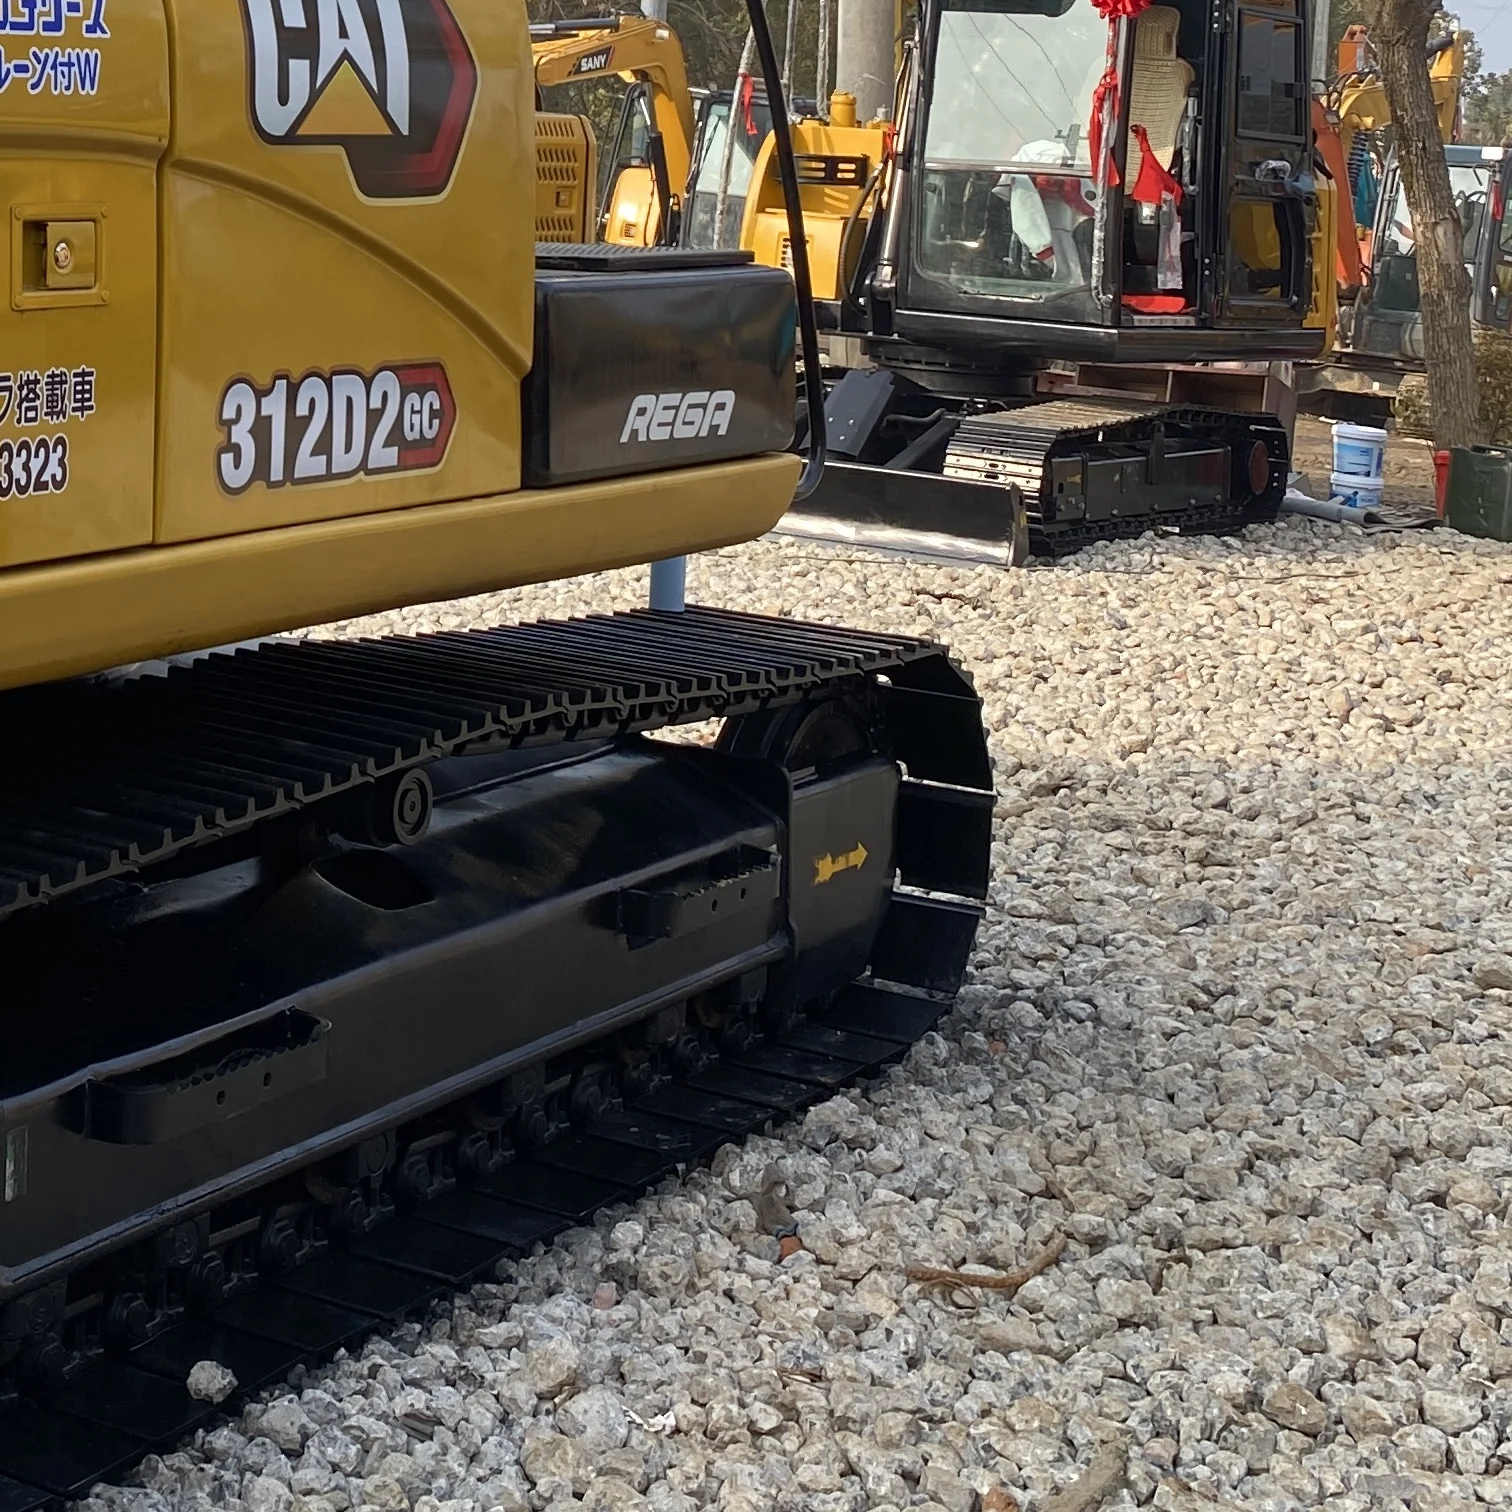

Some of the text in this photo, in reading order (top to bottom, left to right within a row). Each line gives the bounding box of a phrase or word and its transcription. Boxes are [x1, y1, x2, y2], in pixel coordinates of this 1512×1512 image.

[580, 54, 607, 71] SANY
[220, 370, 441, 489] 312D2 GC
[619, 390, 736, 443] REGA
